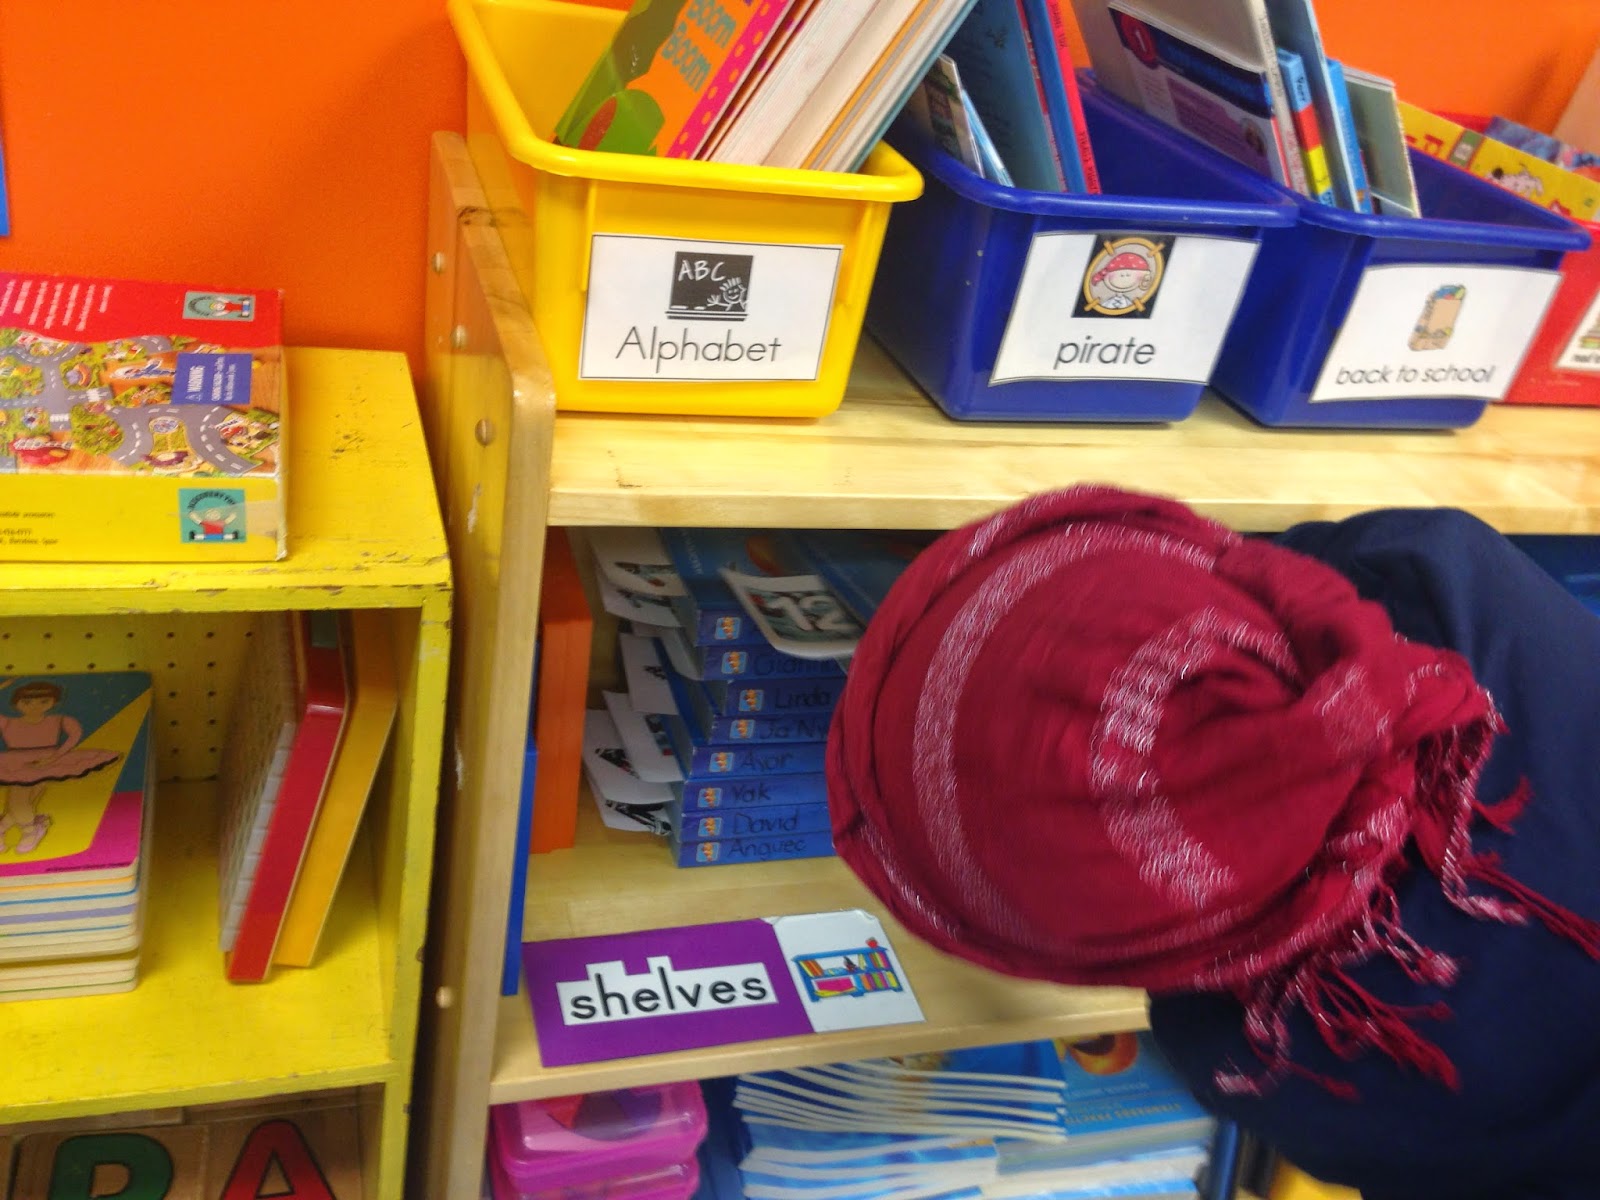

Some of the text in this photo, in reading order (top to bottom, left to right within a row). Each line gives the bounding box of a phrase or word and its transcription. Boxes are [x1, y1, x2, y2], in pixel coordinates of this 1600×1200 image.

[661, 20, 711, 93] Boom
[678, 259, 726, 282] ABC
[615, 325, 782, 374] Alphabet
[1053, 335, 1156, 370] pirate
[1336, 363, 1497, 385] back to school
[732, 809, 801, 835] David
[570, 966, 768, 1020] shelves
